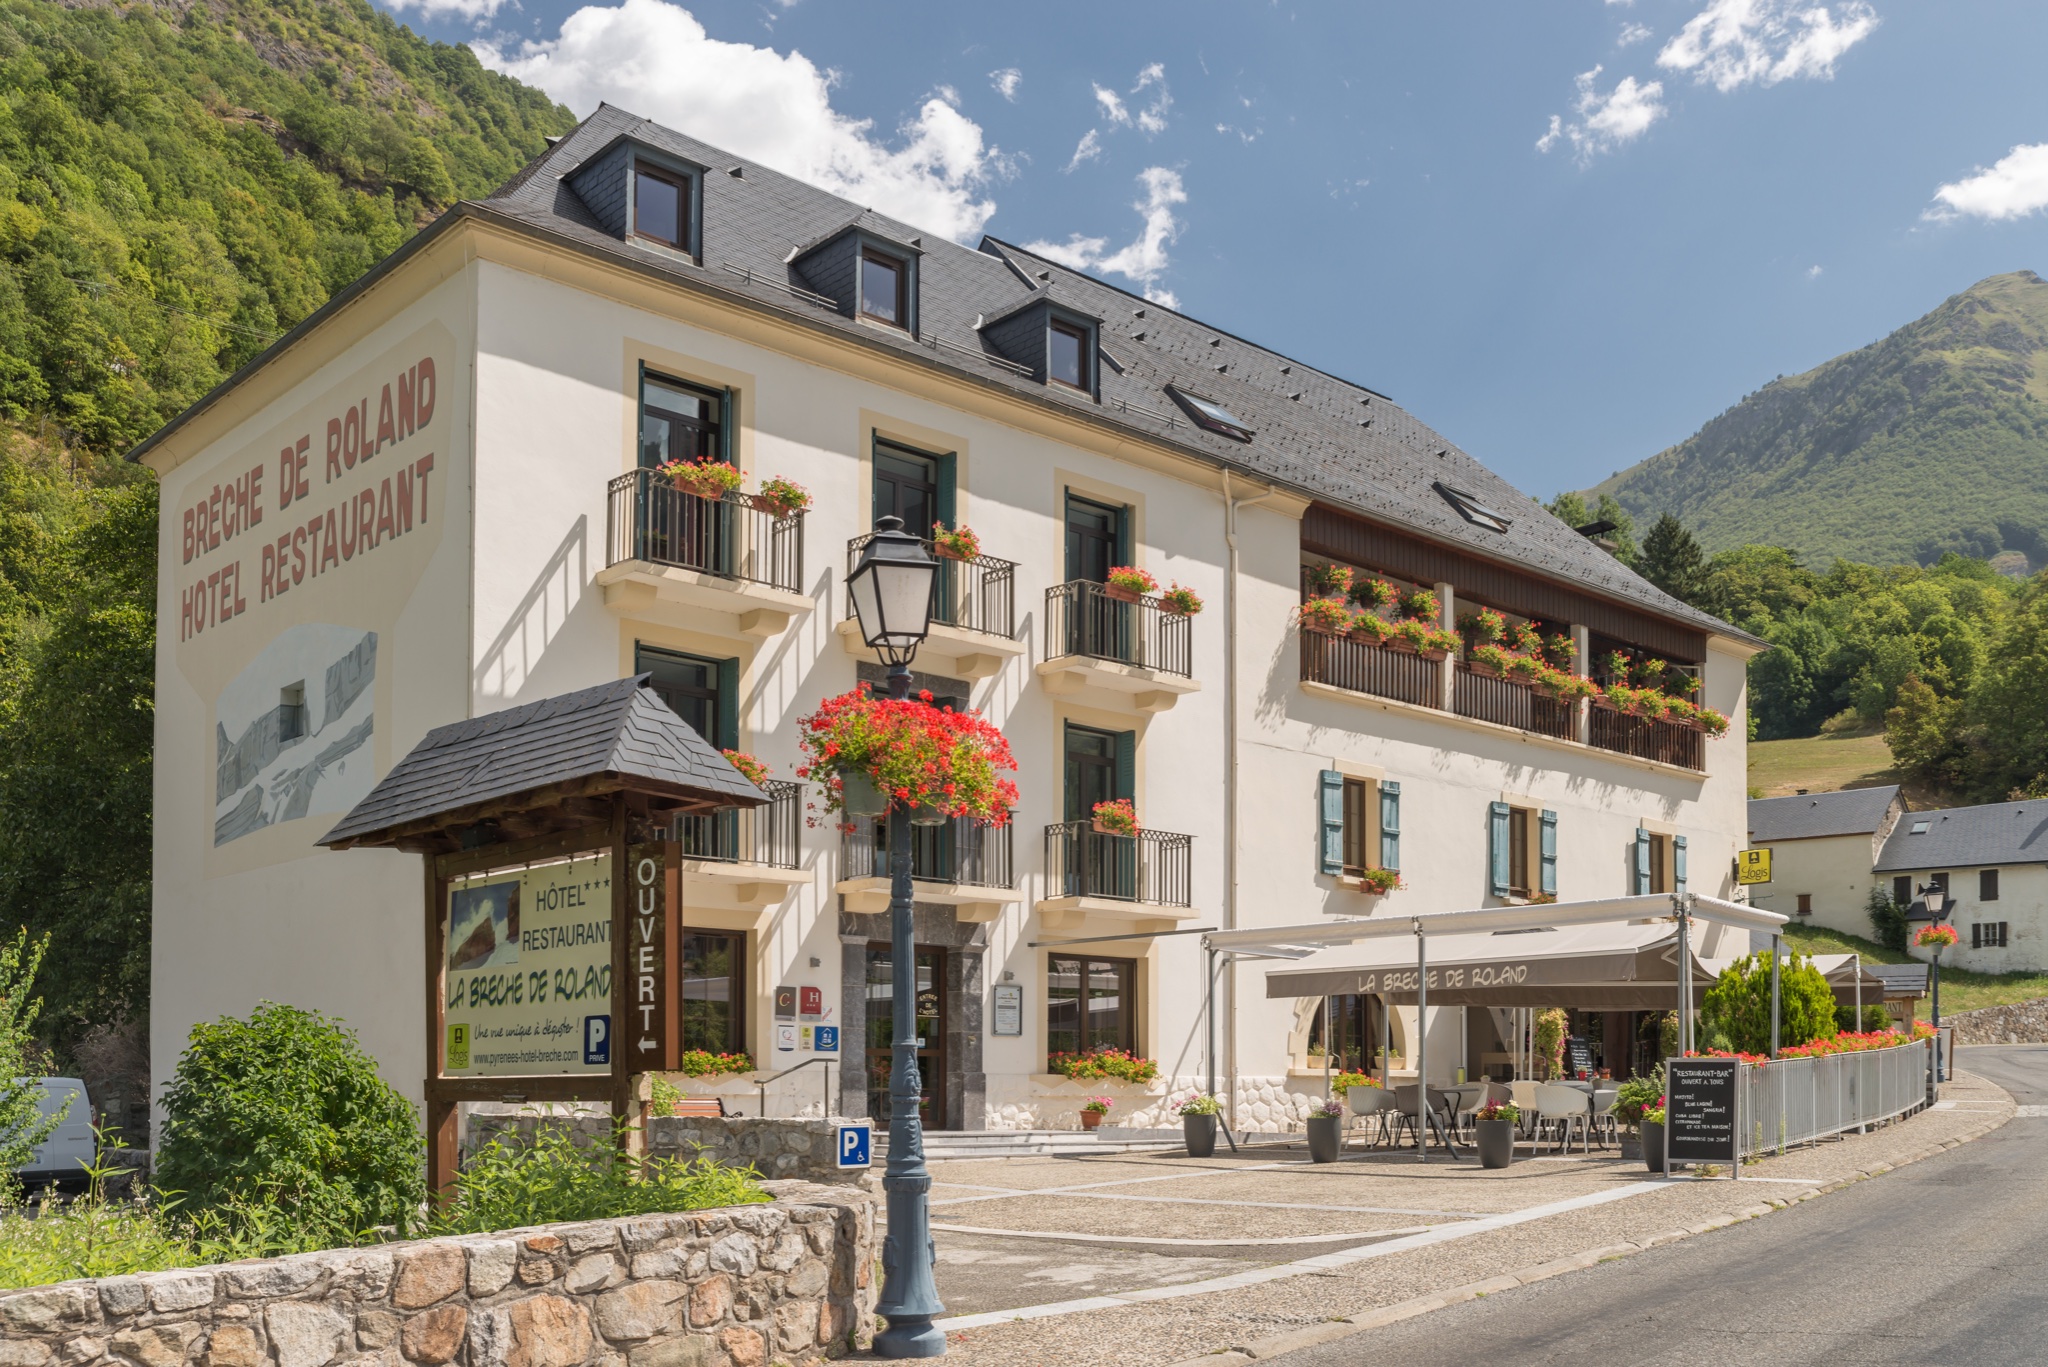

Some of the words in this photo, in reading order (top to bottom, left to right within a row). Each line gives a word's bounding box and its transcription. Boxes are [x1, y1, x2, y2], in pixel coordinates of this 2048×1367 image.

[280, 434, 310, 511] DE
[326, 357, 436, 484] ROLAND
[182, 560, 246, 642] HOTEL
[261, 452, 434, 603] RESTAURANT
[1741, 865, 1768, 880] Logis
[536, 882, 585, 911] HÔTEL
[522, 919, 612, 952] RESTAURANT
[637, 858, 656, 1031] OUVERT
[448, 977, 465, 1009] LA
[469, 971, 523, 1008] BRECHE
[529, 969, 548, 1004] DE
[554, 963, 612, 1002] ROLAND
[1358, 974, 1376, 992] LA
[1445, 968, 1464, 988] DE
[1472, 965, 1527, 986] ROLAND
[809, 991, 819, 1003] H
[474, 1023, 488, 1040] Une
[491, 1027, 503, 1038] vue
[506, 1024, 532, 1042] unique
[534, 1022, 540, 1035] à
[589, 1018, 606, 1053] P
[474, 1049, 578, 1067] www.pyrenees-hotel-breche.com
[844, 1131, 858, 1157] P
